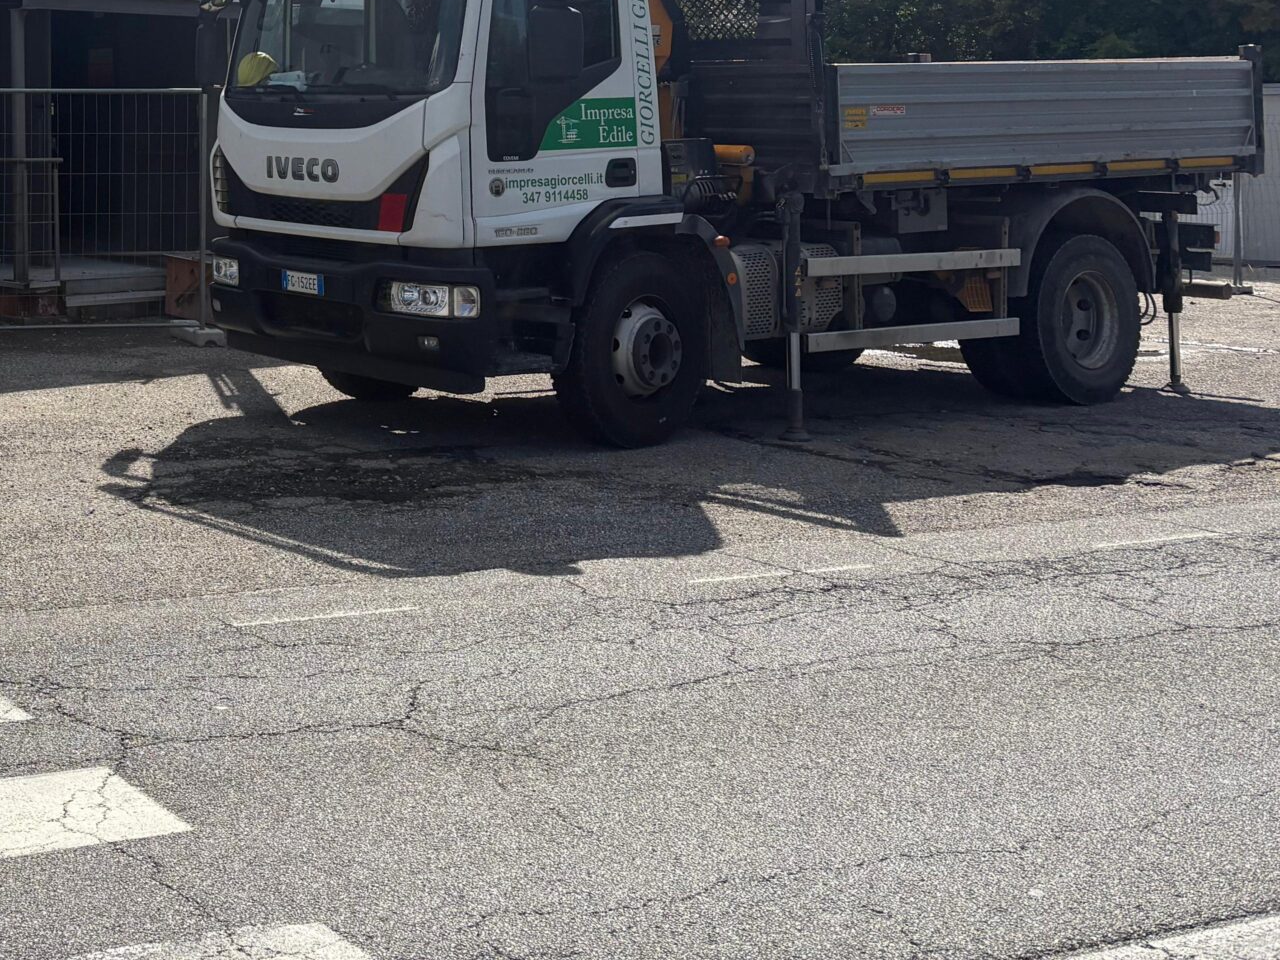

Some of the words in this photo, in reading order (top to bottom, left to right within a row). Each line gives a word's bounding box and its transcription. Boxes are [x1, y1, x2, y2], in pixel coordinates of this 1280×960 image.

[634, 24, 654, 146] GIORCELLI
[580, 103, 634, 126] Impresa
[598, 126, 634, 143] Edile
[266, 155, 340, 183] IVECO
[505, 173, 604, 190] impresagiorcelli.it
[522, 191, 541, 204] 347
[545, 188, 589, 203] 9114458
